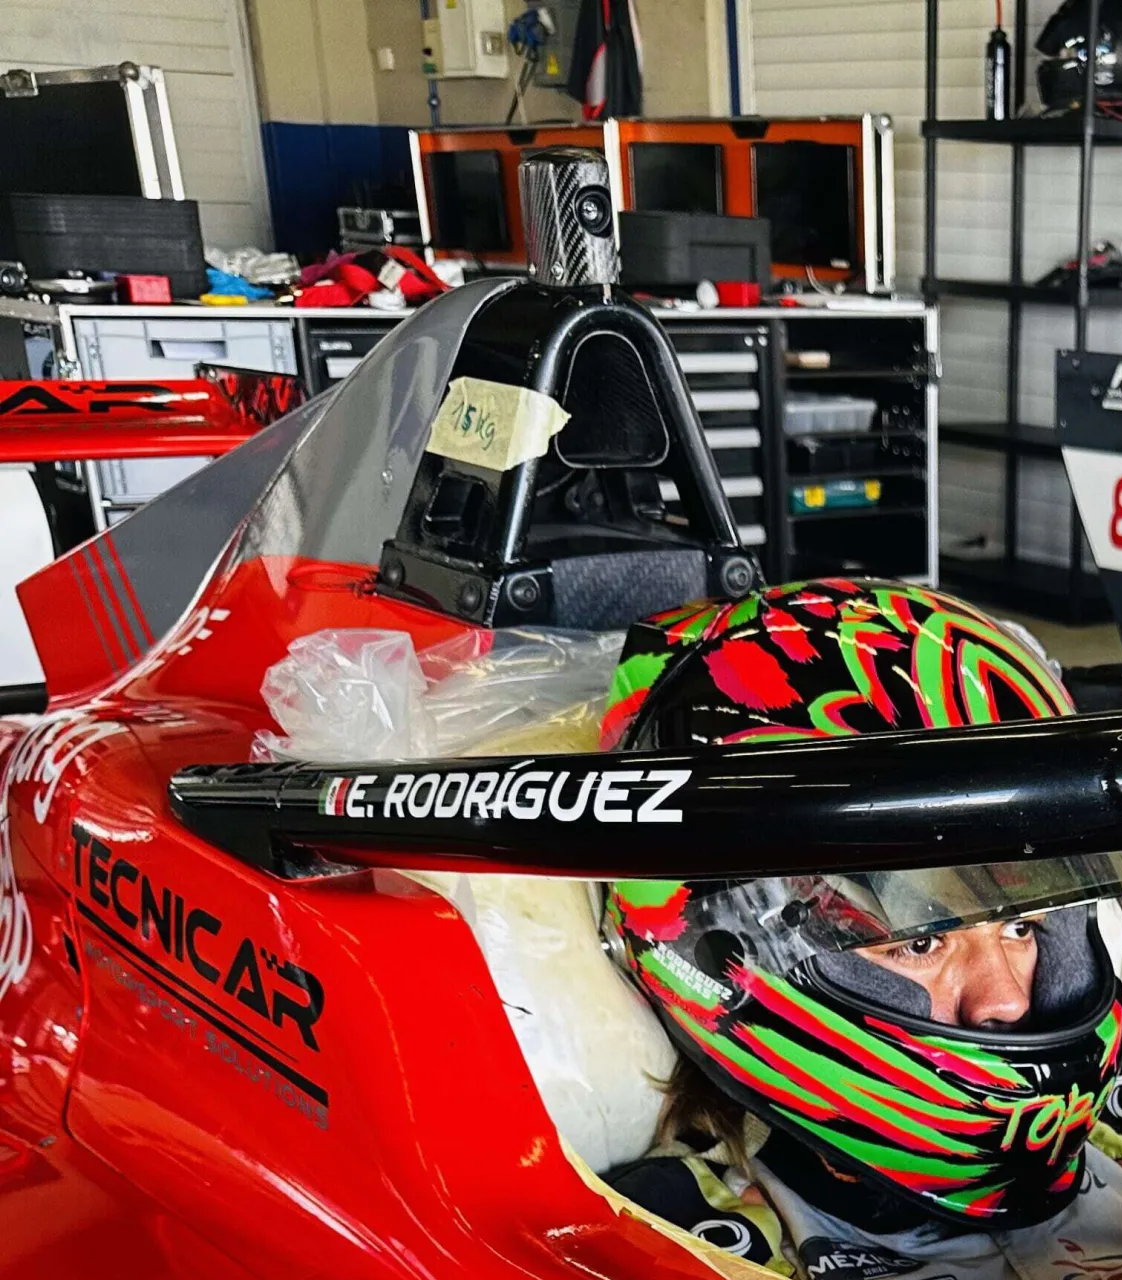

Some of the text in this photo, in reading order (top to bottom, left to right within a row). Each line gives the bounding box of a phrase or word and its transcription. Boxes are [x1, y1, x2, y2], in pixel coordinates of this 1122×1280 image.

[347, 759, 692, 822] E. RODRÍGUEZ
[72, 821, 326, 1053] TECNICAR
[204, 1031, 329, 1131] SOLUTIONS
